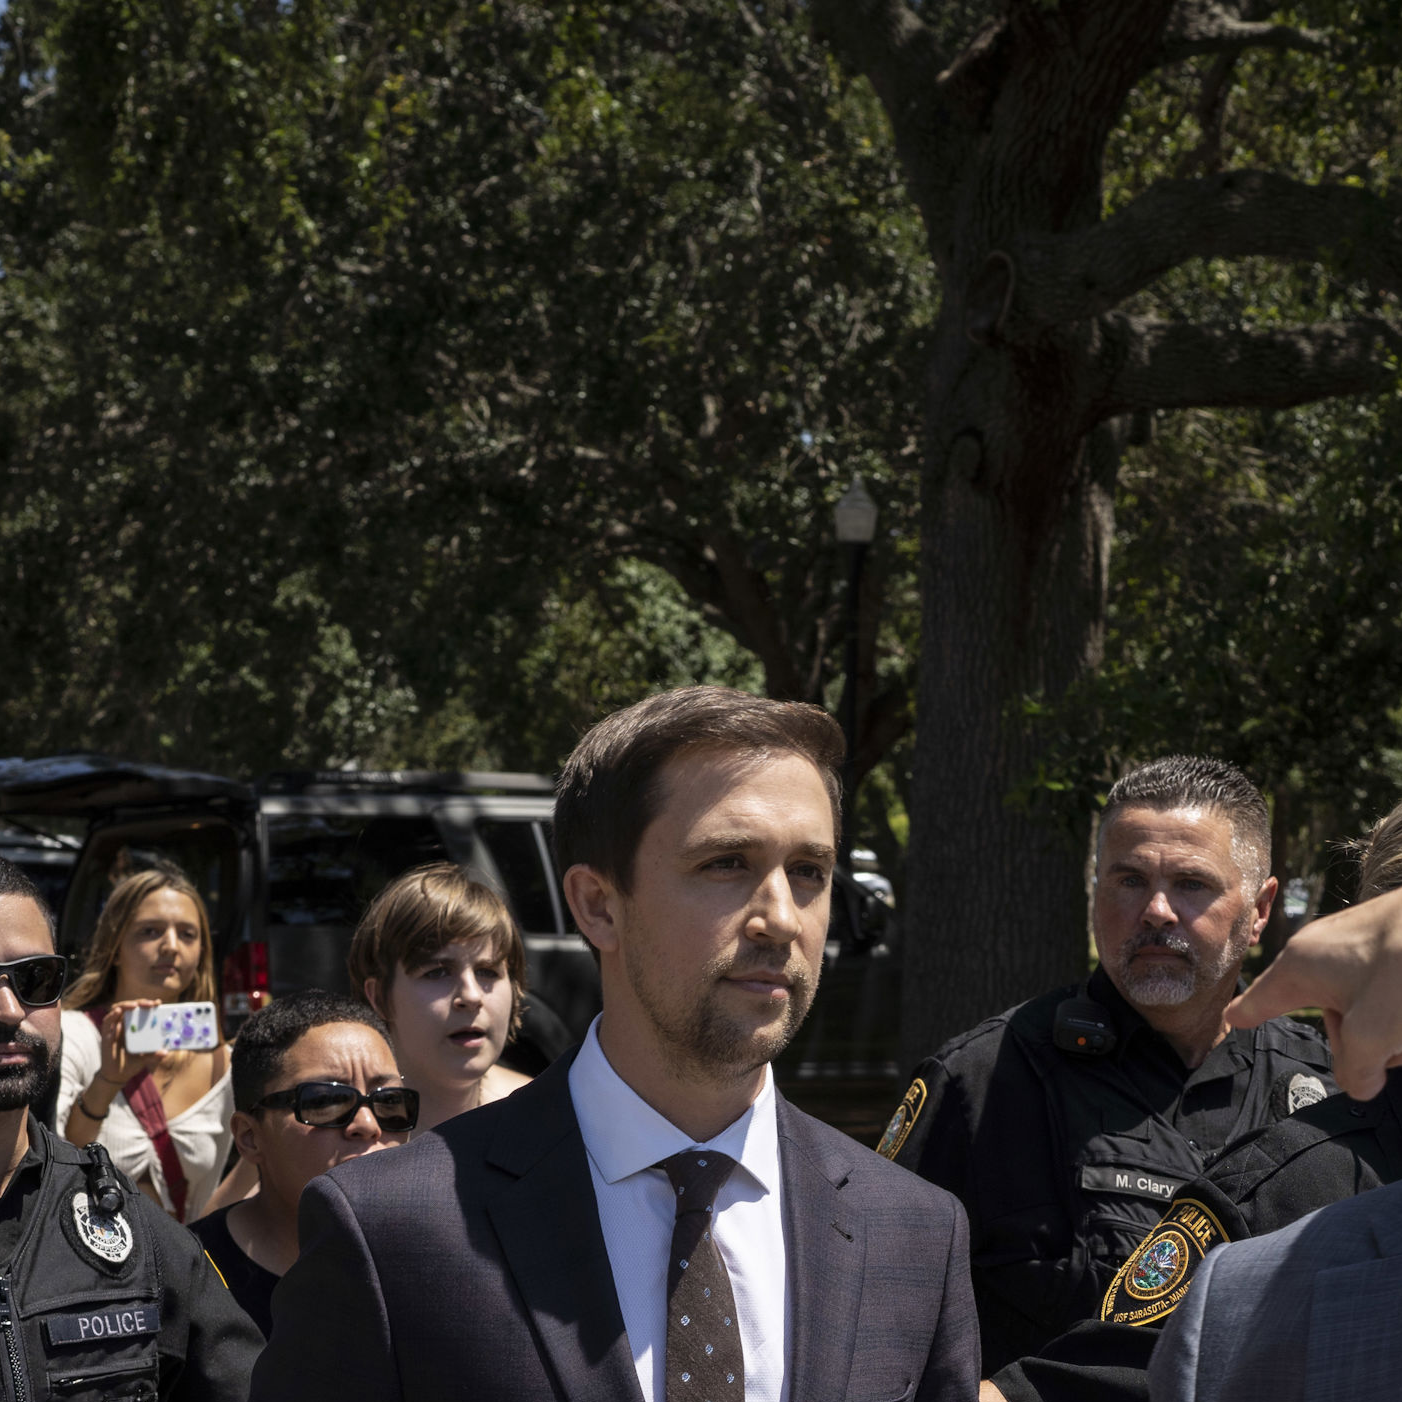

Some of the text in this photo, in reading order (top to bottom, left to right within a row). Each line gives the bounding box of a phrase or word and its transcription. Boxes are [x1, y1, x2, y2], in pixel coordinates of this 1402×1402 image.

[1116, 1174, 1175, 1198] M. Clary
[1173, 1205, 1217, 1248] POLICE
[78, 1311, 146, 1338] POLICE
[1113, 1313, 1129, 1324] USF
